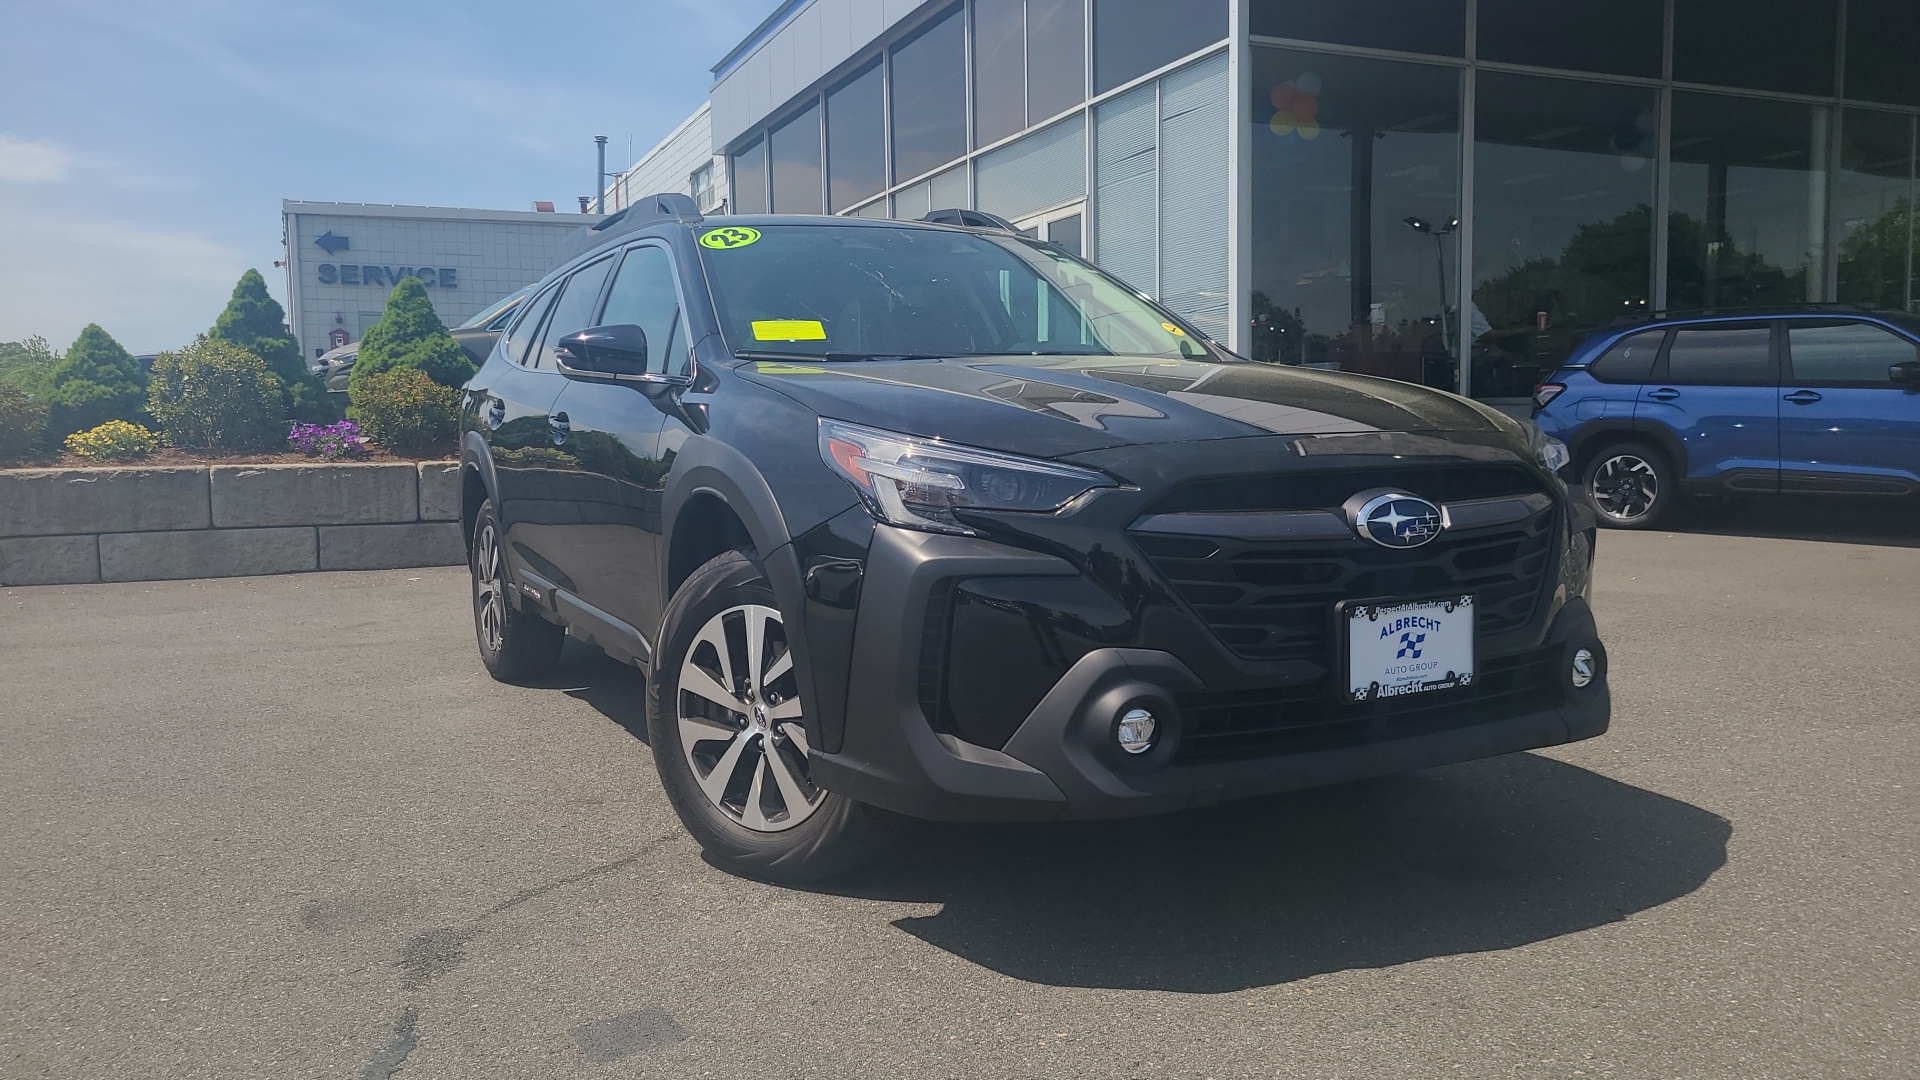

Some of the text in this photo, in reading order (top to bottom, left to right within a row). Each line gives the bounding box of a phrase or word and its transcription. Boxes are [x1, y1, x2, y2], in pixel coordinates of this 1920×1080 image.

[711, 229, 749, 247] 23
[1380, 617, 1441, 639] ALBRECHT
[1384, 661, 1438, 676] AUTO GROUP
[1376, 681, 1455, 698] Albrecht AUTO GROUP
